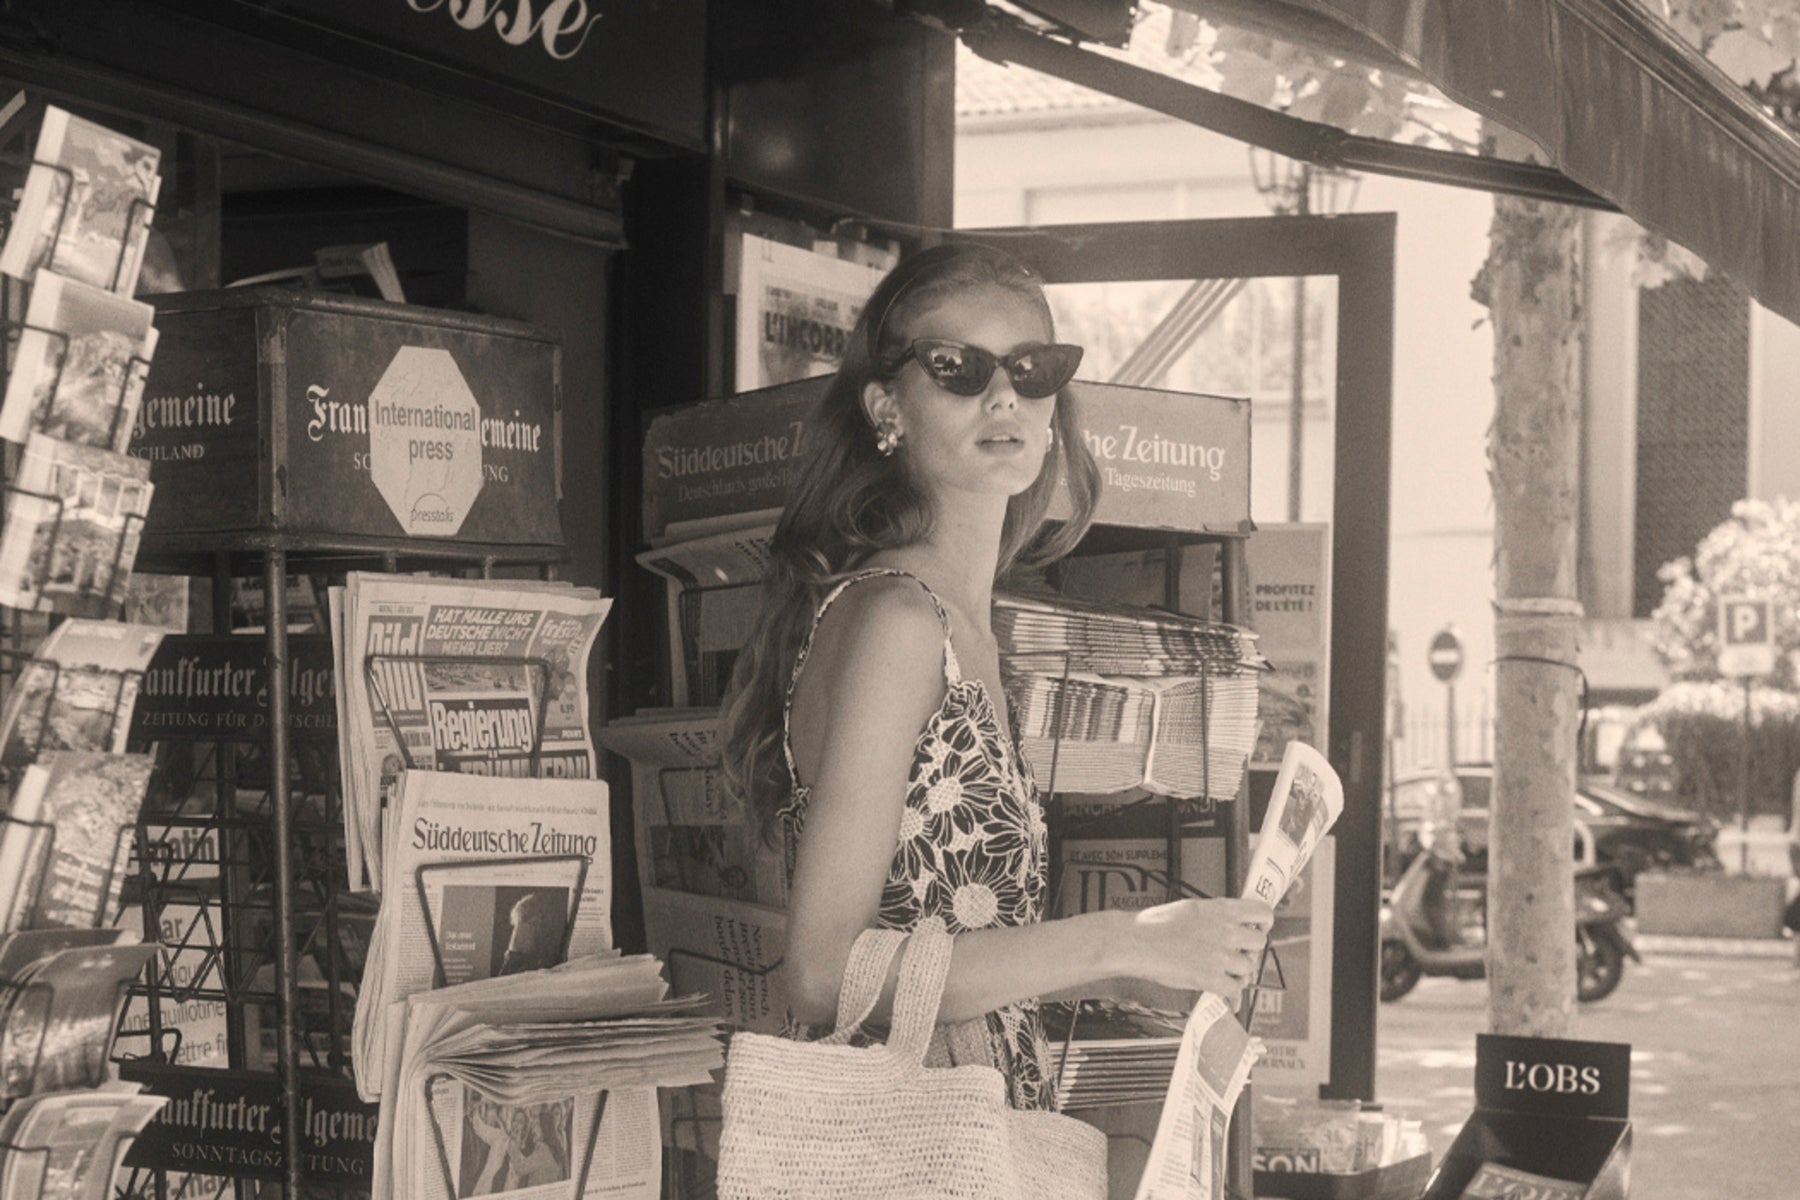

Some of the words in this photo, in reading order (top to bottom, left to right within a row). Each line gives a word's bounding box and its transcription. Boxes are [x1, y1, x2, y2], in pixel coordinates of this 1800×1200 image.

[374, 399, 476, 433] International
[409, 438, 454, 465] press
[1119, 424, 1226, 481] Zeitung
[1105, 466, 1197, 498] Tageszeitung
[1255, 584, 1315, 596] PROFITEZ
[434, 608, 463, 625] HAT
[460, 609, 506, 627] MALLE
[505, 611, 534, 627] UNS
[1255, 601, 1271, 612] DE
[426, 624, 491, 641] DEUTSCHE
[490, 625, 533, 641] NICHT
[1731, 605, 1758, 638] P
[441, 640, 476, 655] MEHR
[477, 640, 510, 655] LIEB?
[142, 710, 209, 728] ZEITUNG
[216, 709, 246, 728] FÜR
[431, 700, 533, 754] Regierung
[412, 817, 529, 855] Süddeutsche
[530, 821, 598, 857] Zeitung
[1504, 1060, 1601, 1095] L'OBS
